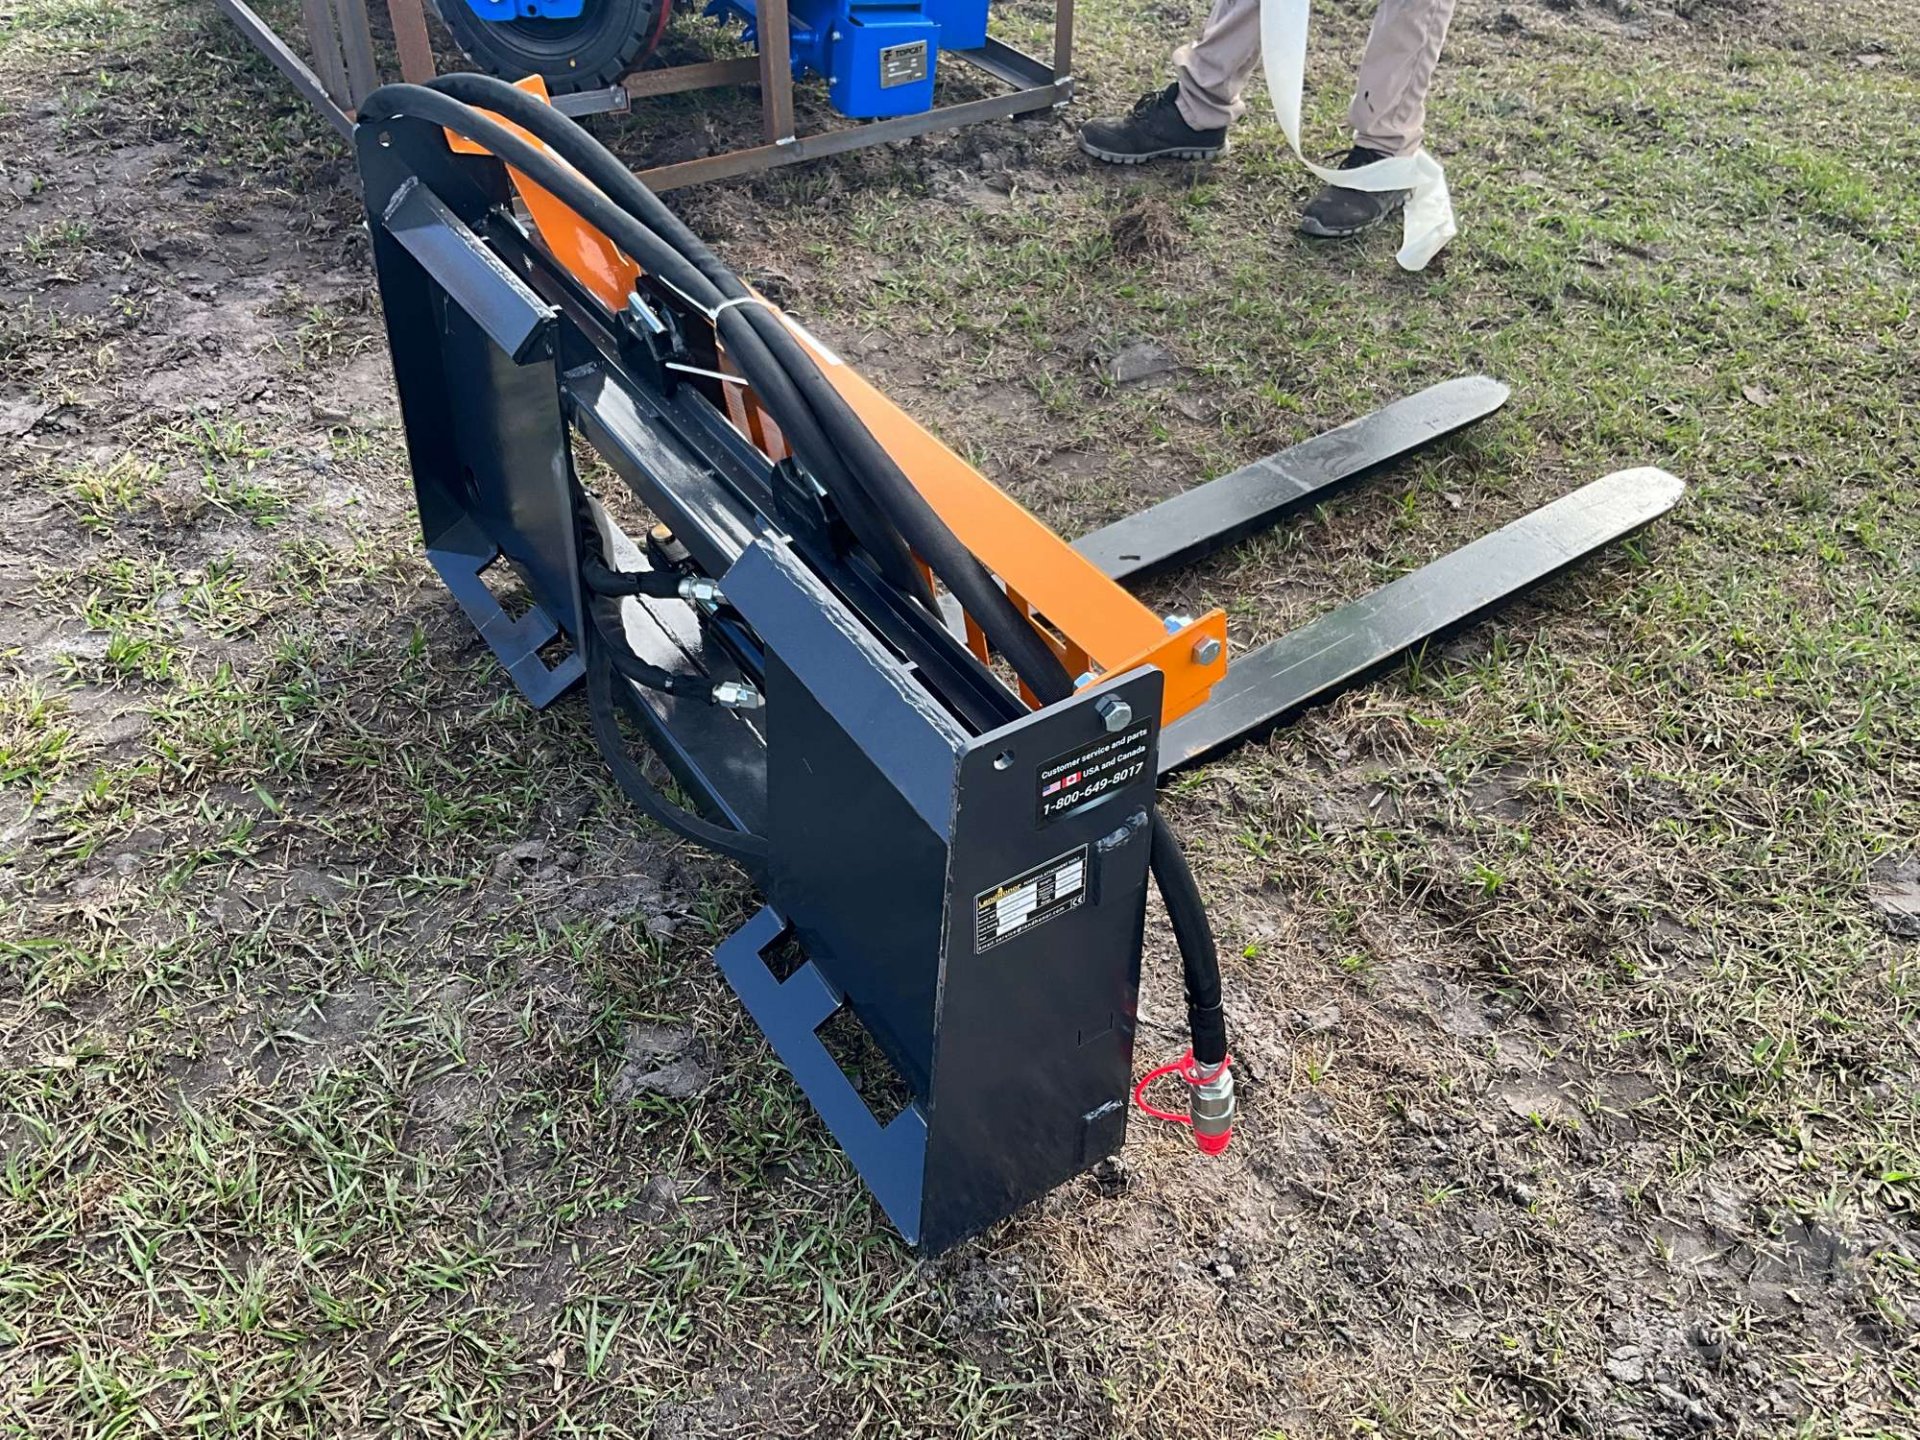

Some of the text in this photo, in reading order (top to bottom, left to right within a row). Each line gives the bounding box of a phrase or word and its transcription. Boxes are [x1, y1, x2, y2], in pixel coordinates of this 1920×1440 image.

[895, 46, 923, 57] TOPCAT
[1041, 729, 1148, 779] Customer service and parts
[1083, 746, 1146, 778] USA and Canada
[1043, 762, 1144, 815] 1-800-649-8017
